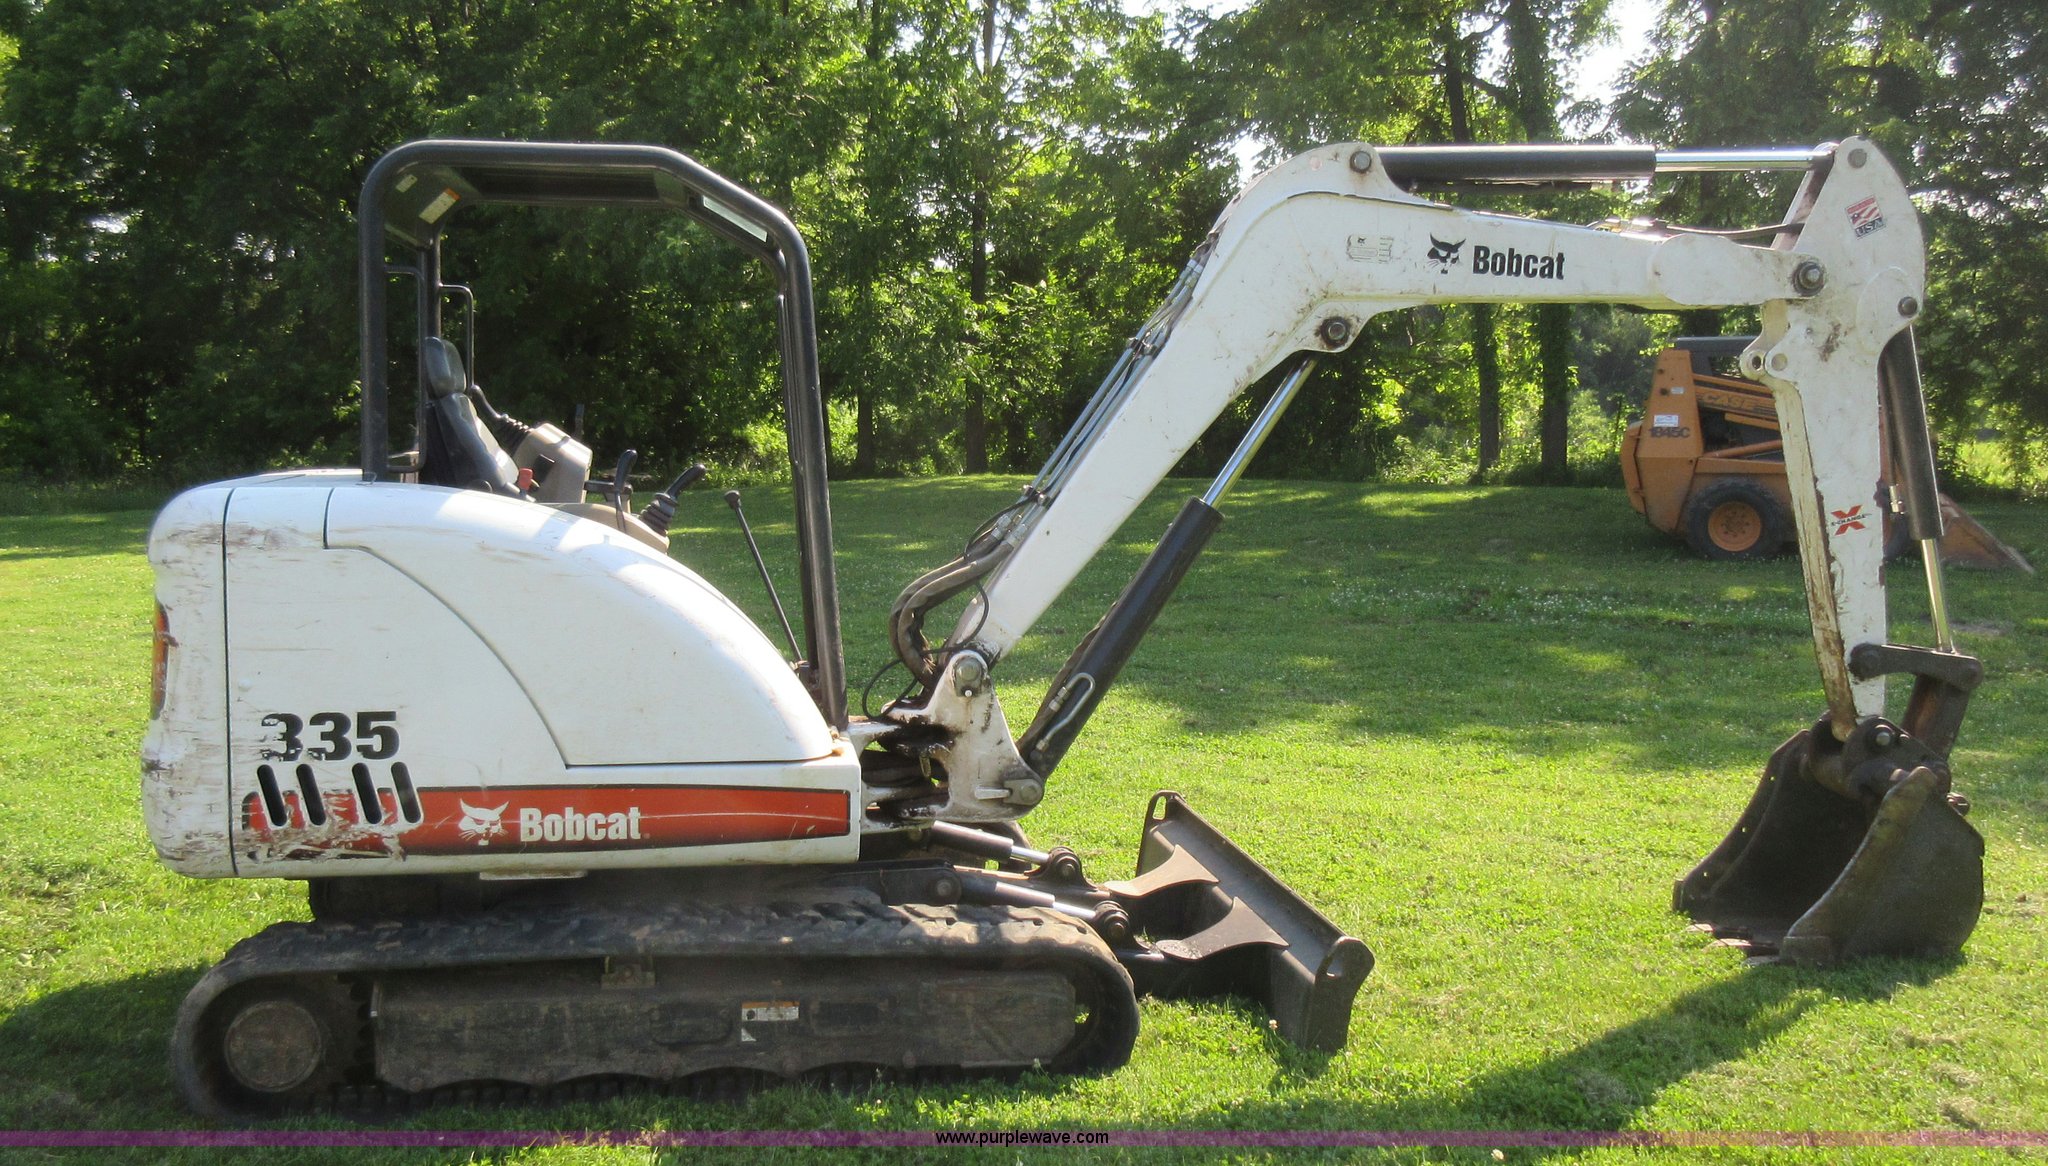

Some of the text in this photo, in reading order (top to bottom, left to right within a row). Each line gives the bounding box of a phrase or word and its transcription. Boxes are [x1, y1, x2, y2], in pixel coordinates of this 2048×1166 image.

[1856, 218, 1885, 237] USA
[1473, 245, 1565, 280] Bobcat
[1649, 426, 1691, 438] 1845C
[260, 711, 400, 762] 335
[519, 806, 641, 842] Bobcat
